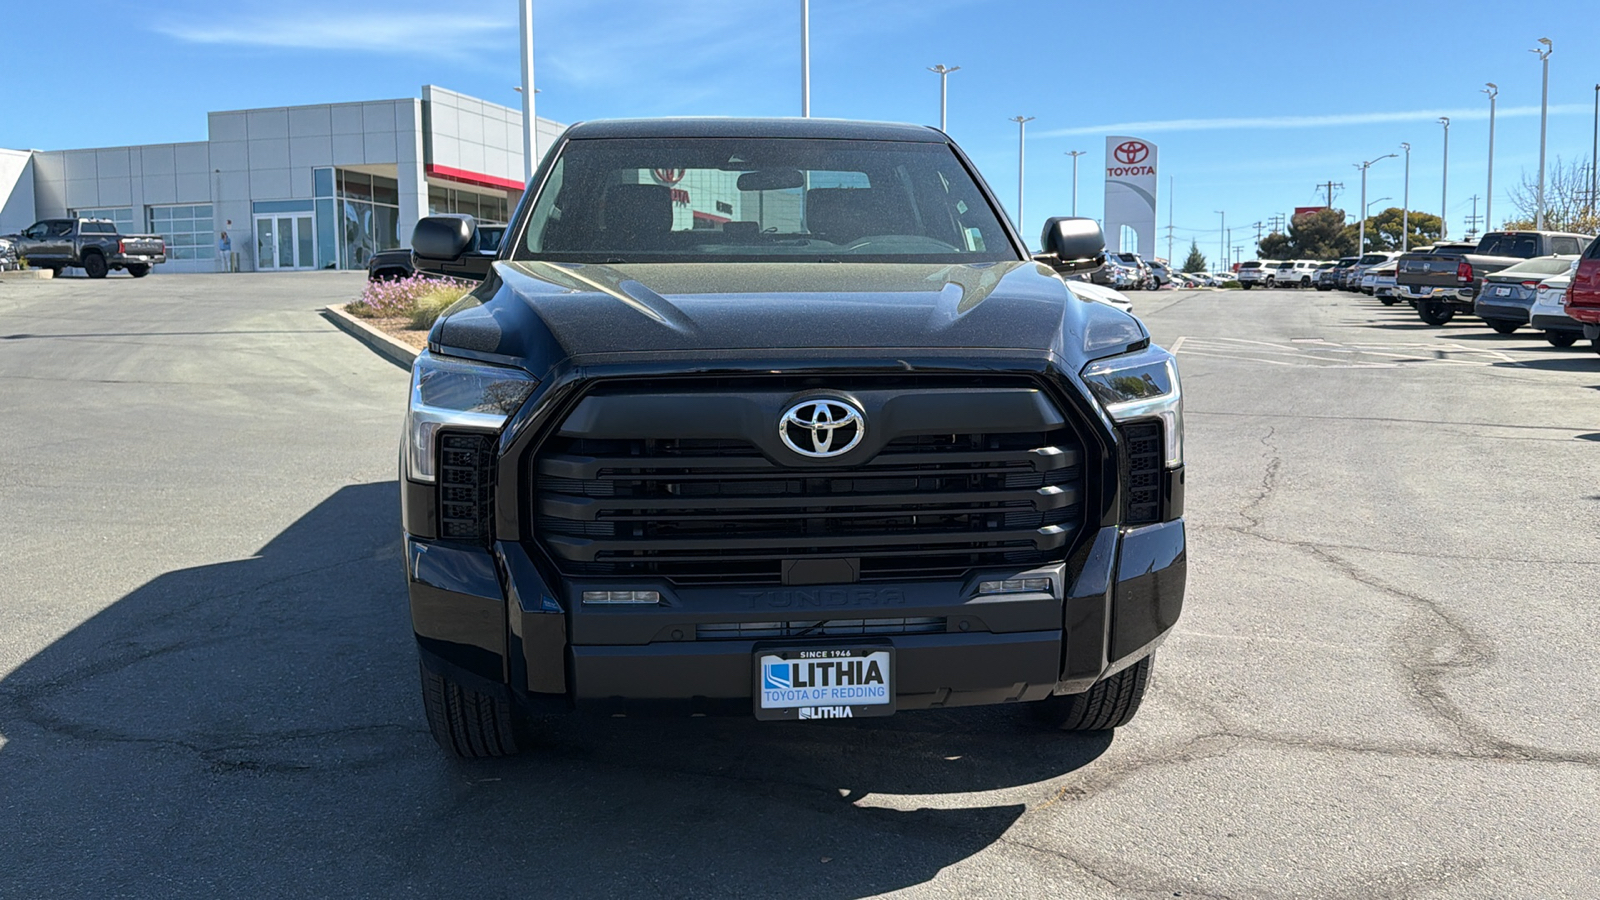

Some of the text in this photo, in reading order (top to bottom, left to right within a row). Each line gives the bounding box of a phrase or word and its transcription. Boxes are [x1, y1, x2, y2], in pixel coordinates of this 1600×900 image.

[1107, 166, 1155, 177] TOYOTA
[738, 587, 906, 608] TUNDRA
[792, 660, 884, 688] LITHIA
[764, 687, 885, 702] TOYOTA OF REDDING
[811, 706, 853, 719] LITHIA
